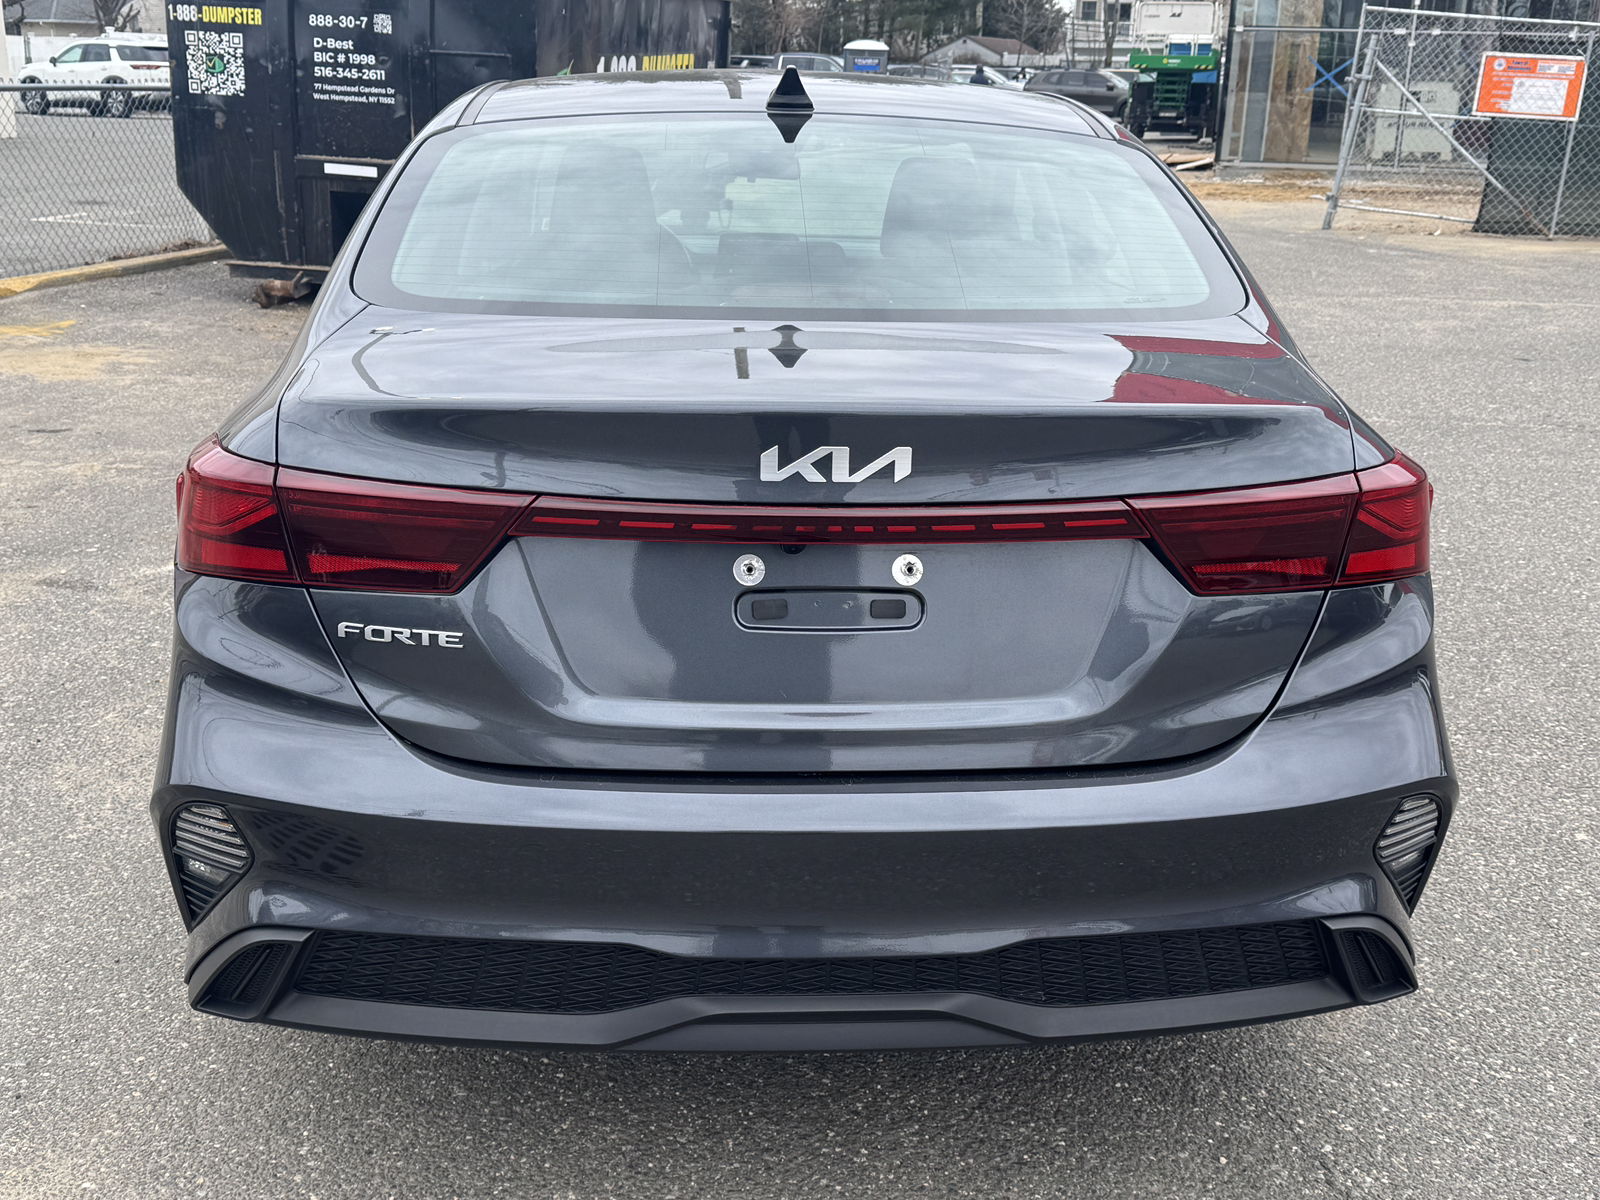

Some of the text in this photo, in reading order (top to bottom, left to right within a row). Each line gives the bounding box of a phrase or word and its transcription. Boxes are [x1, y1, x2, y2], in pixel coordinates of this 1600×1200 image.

[168, 3, 262, 25] 1-888-DUMPSTER
[308, 13, 368, 29] 888-30-7
[313, 37, 354, 50] D-Best
[313, 51, 376, 65] BIC # 1998
[313, 66, 386, 81] 516-345-2611
[322, 83, 359, 93] Hempstead
[359, 86, 386, 94] Gardens
[386, 87, 395, 95] Dr
[330, 94, 368, 103] Hempstead,
[380, 97, 396, 105] 11552
[760, 444, 913, 483] KIA
[337, 621, 465, 649] FORTE
